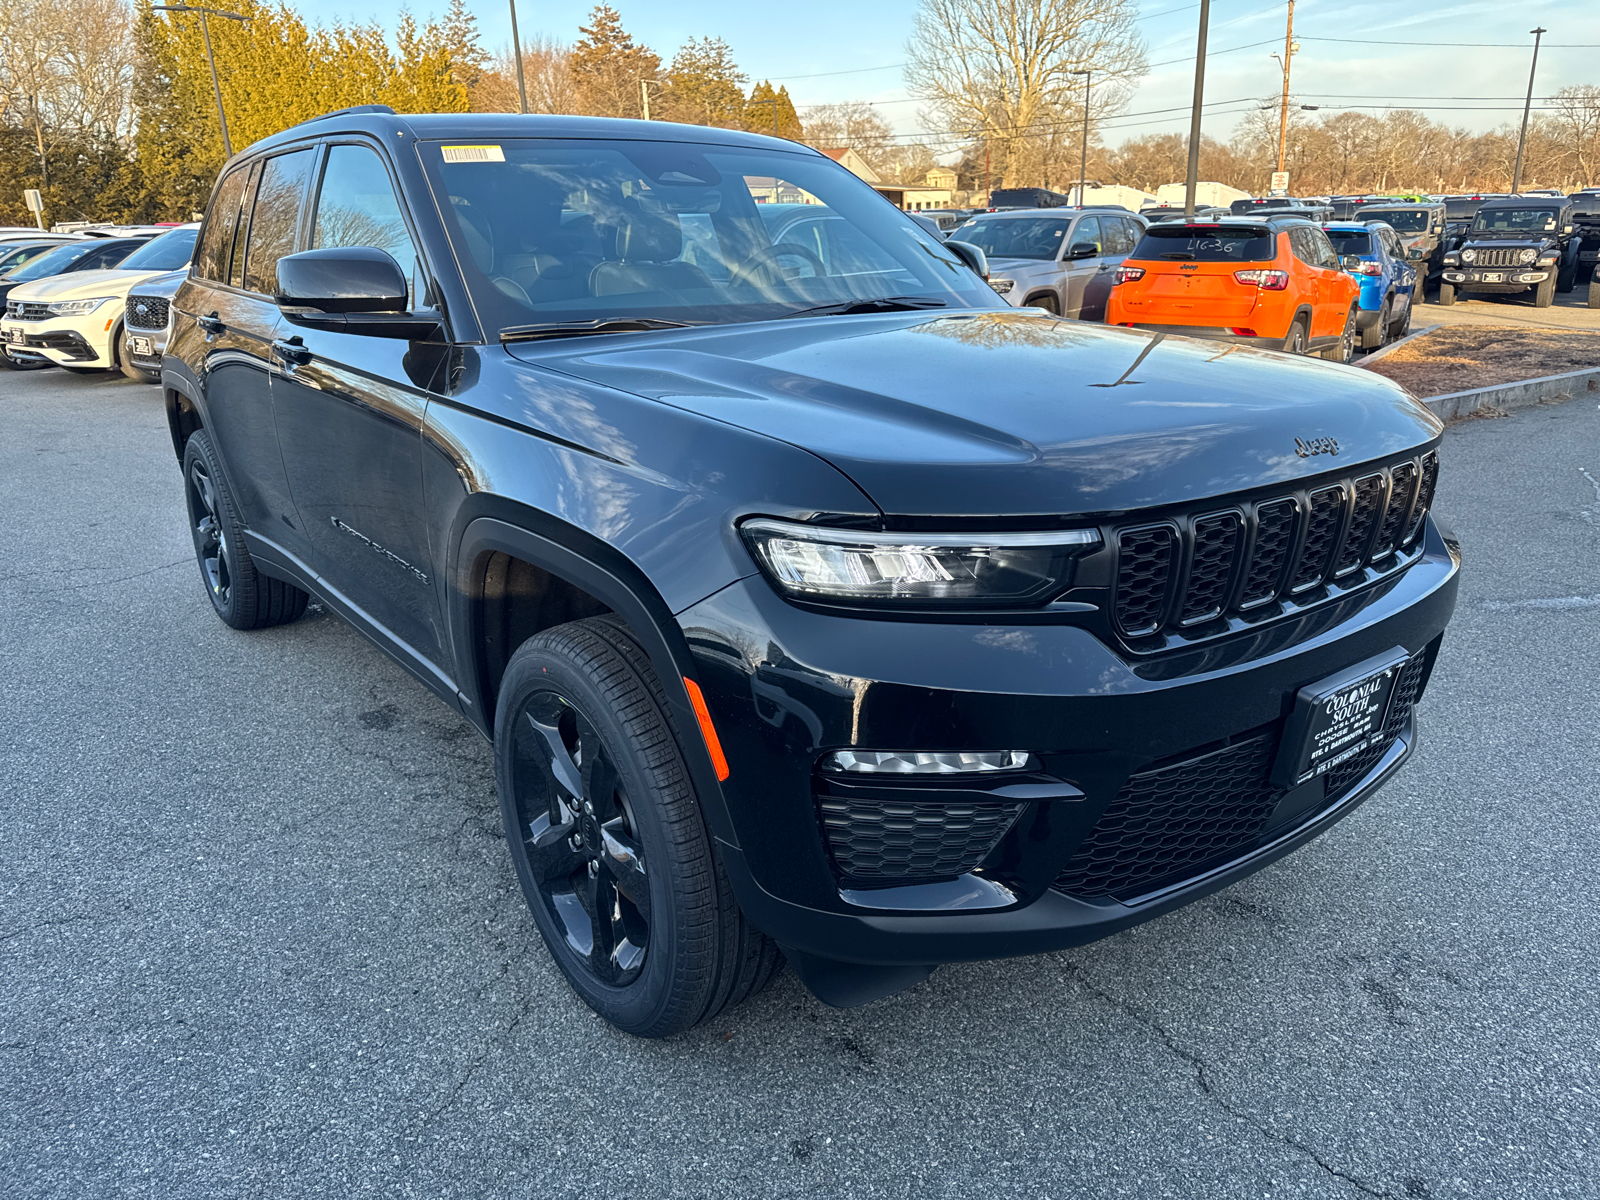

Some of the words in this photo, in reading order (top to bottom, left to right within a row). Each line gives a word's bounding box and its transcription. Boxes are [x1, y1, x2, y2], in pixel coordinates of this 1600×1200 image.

[1180, 263, 1198, 271] Jeep
[1294, 436, 1340, 458] Jeep
[1326, 678, 1381, 714] COLONIAL
[1331, 695, 1370, 725] SOUTH
[1314, 713, 1362, 740] CHRYSLER
[1318, 727, 1349, 747] DODGE
